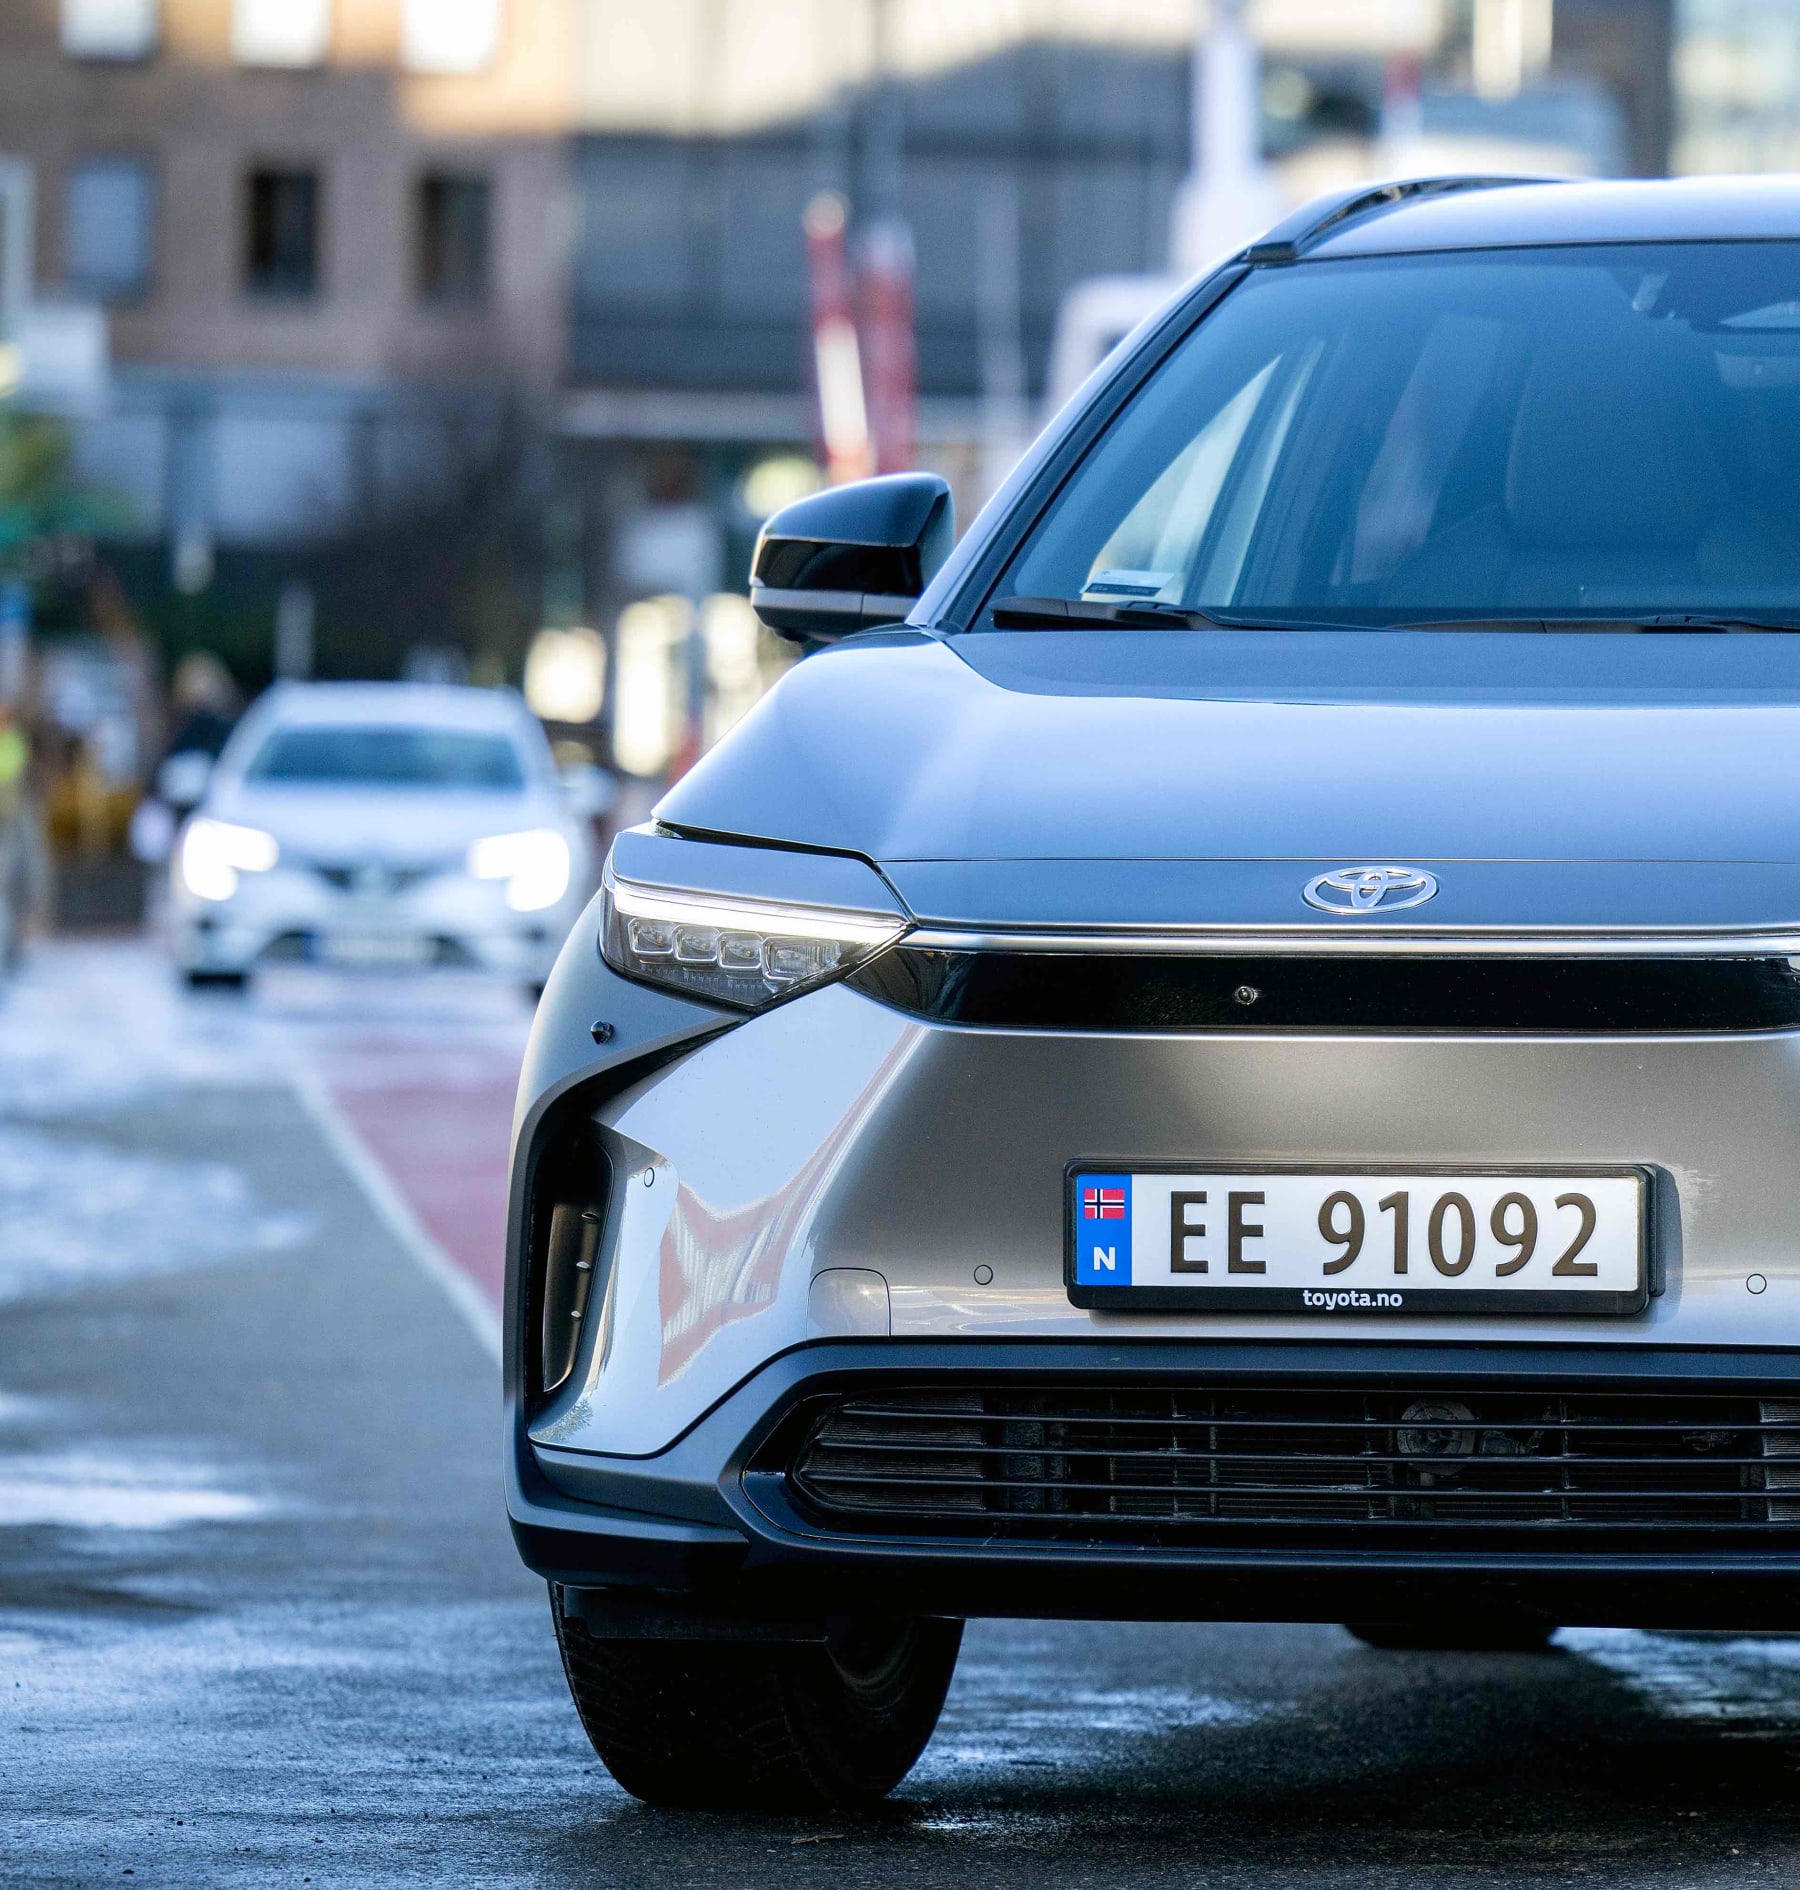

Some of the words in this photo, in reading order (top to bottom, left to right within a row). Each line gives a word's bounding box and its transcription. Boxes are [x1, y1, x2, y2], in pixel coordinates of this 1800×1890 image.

[1170, 1190, 1267, 1274] EE
[1317, 1190, 1599, 1278] 91092
[1093, 1246, 1116, 1271] N
[1302, 1288, 1403, 1311] toyota.no
